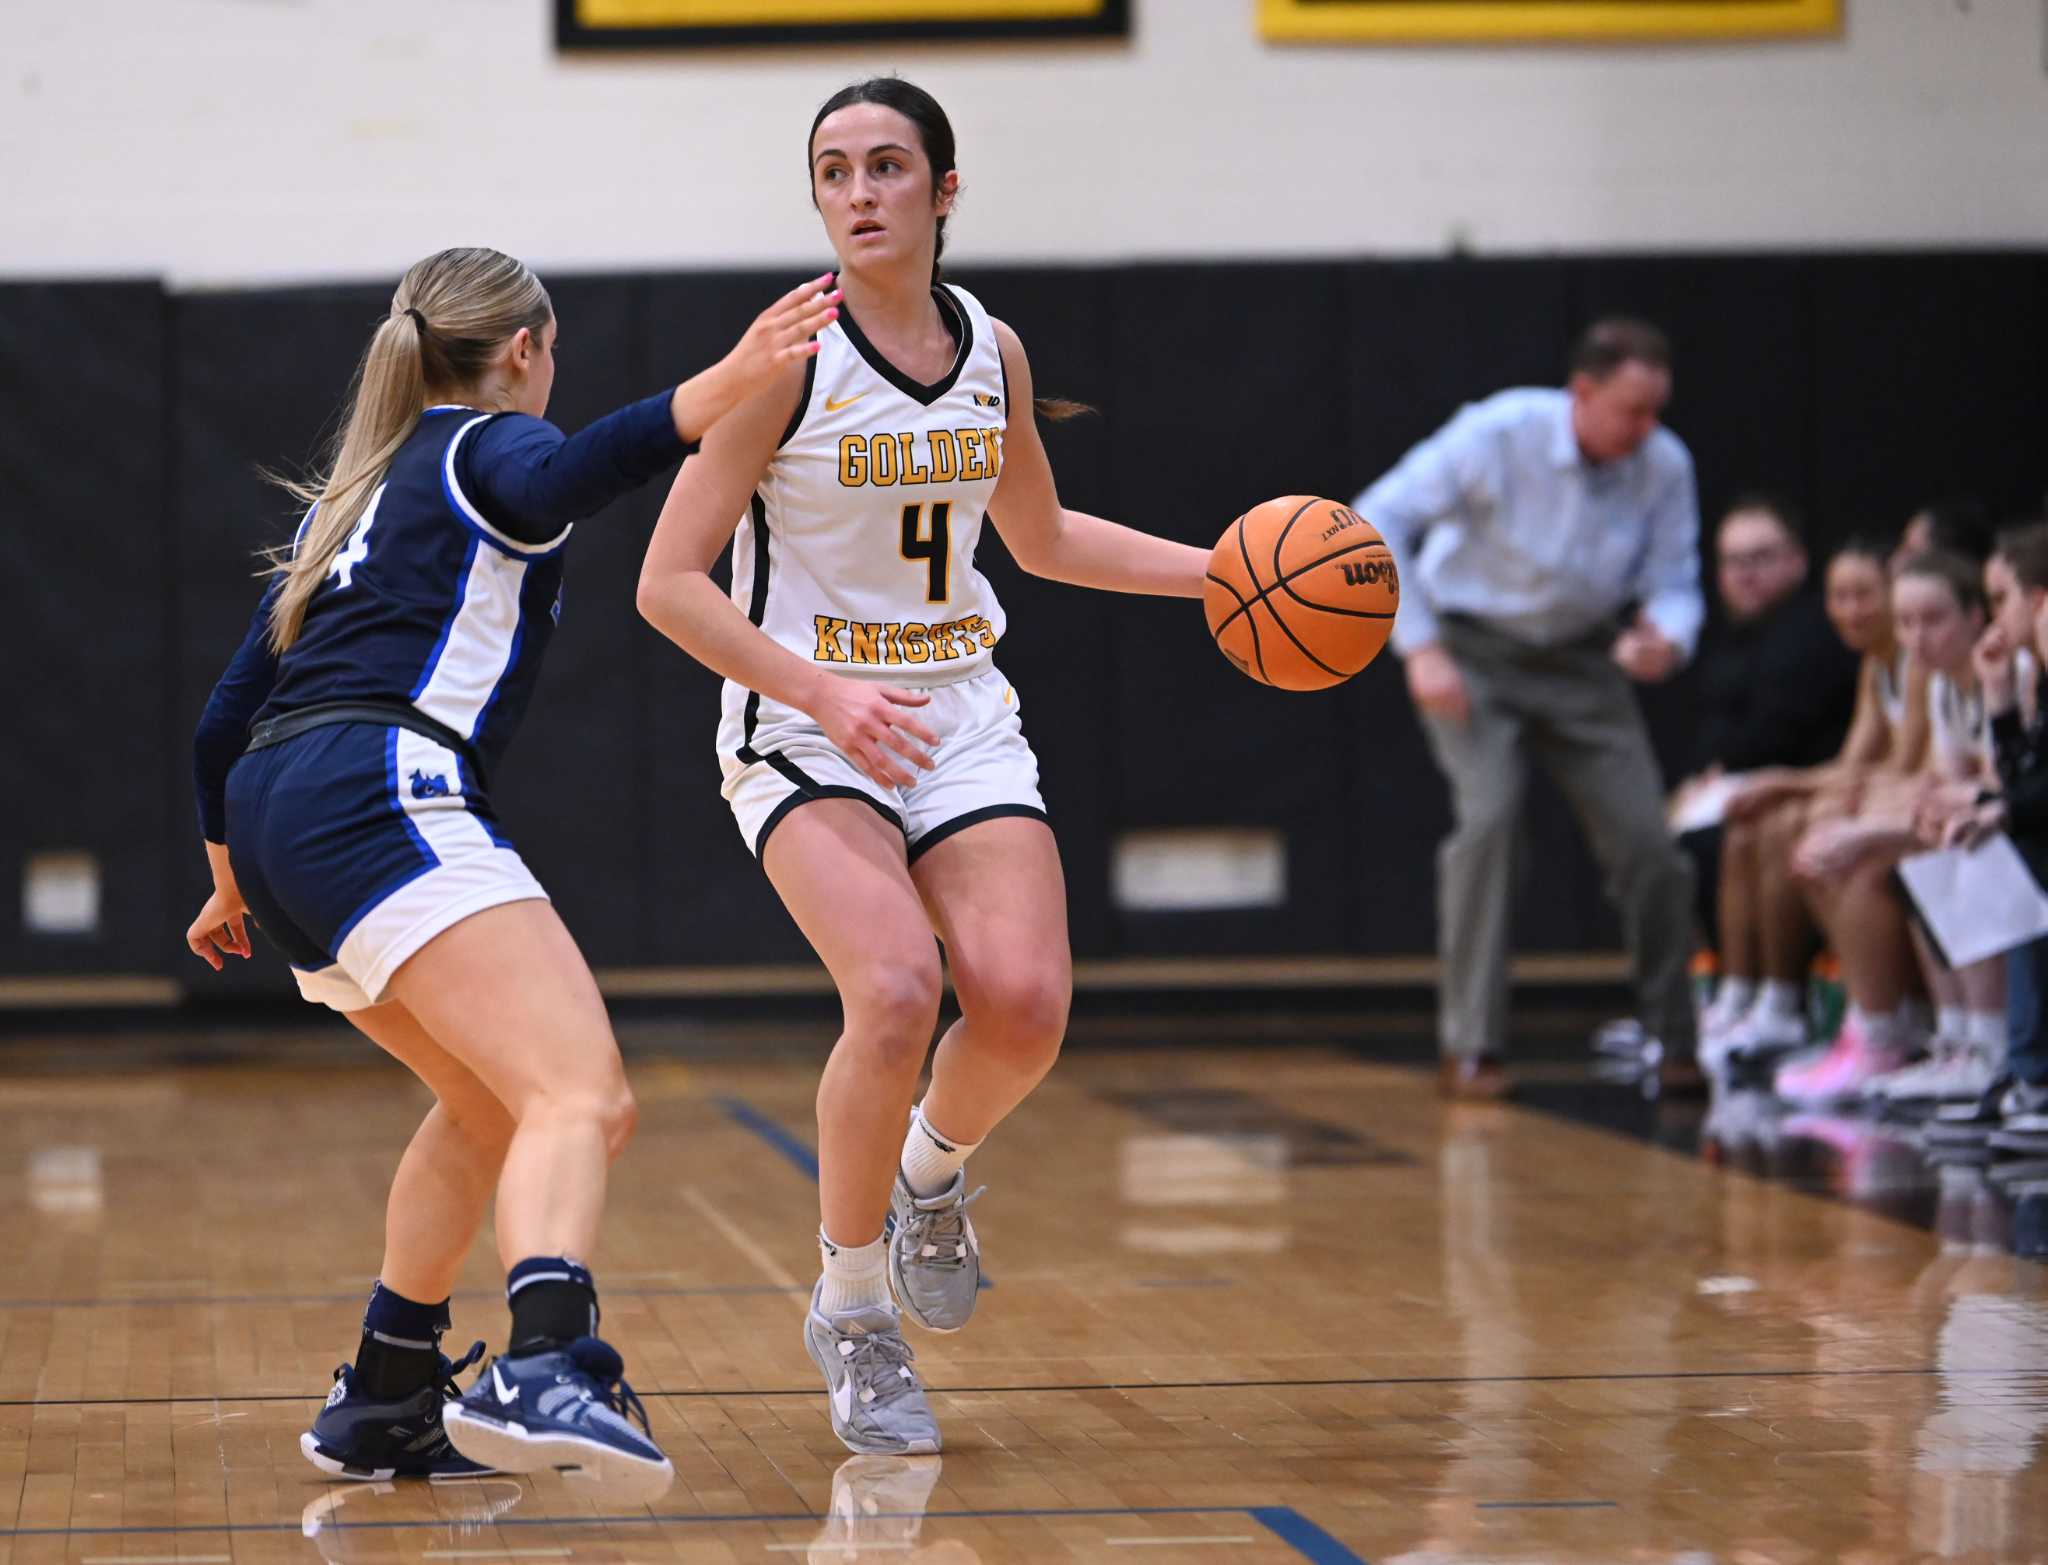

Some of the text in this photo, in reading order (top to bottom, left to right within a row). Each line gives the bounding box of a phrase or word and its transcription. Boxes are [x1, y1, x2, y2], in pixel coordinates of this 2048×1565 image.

[838, 428, 999, 487] GOLDEN
[901, 501, 951, 602] 4
[1321, 525, 1340, 542] NXT
[814, 614, 996, 664] KNIGHTS
